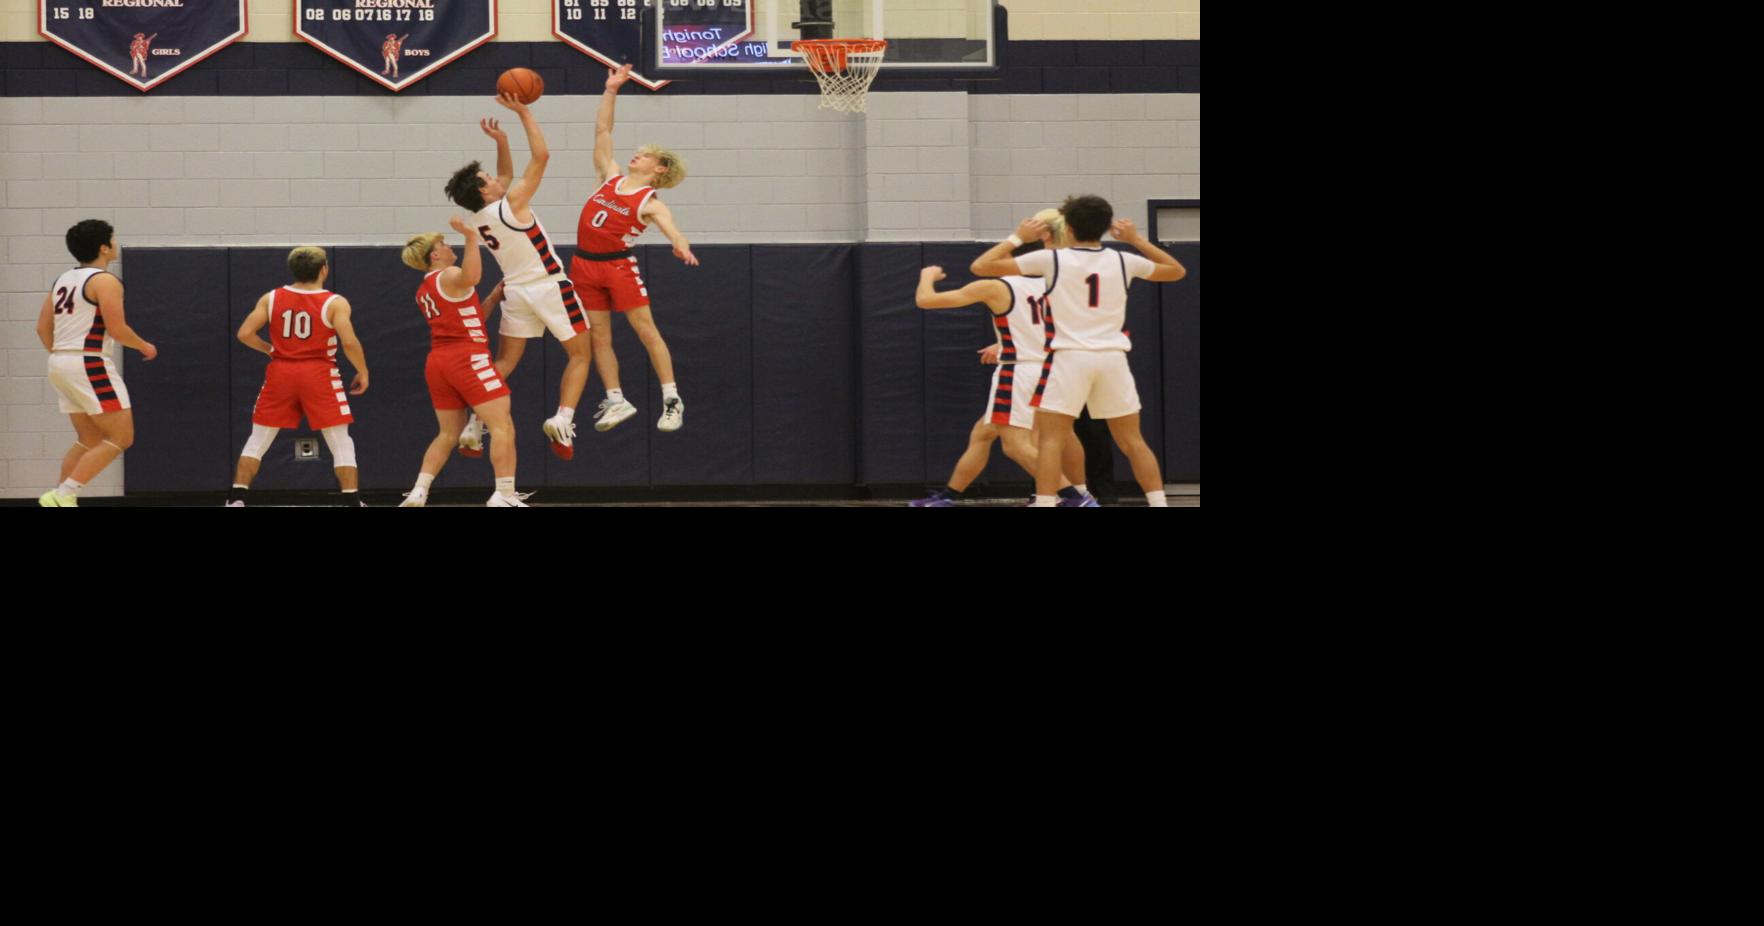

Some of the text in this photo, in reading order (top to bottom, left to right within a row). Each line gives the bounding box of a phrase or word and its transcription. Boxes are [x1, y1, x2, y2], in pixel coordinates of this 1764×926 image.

[355, 0, 434, 8] REGIONAL
[53, 8, 94, 20] 15 18
[306, 9, 435, 21] 02 06 07 16 17 18
[566, 8, 636, 20] 10 11 12
[404, 49, 430, 57] BOYS
[591, 210, 609, 228] 0
[478, 225, 500, 250] 5
[1085, 273, 1100, 308] 1
[54, 286, 77, 314] 24
[420, 293, 440, 319] 11
[282, 309, 311, 339] 10
